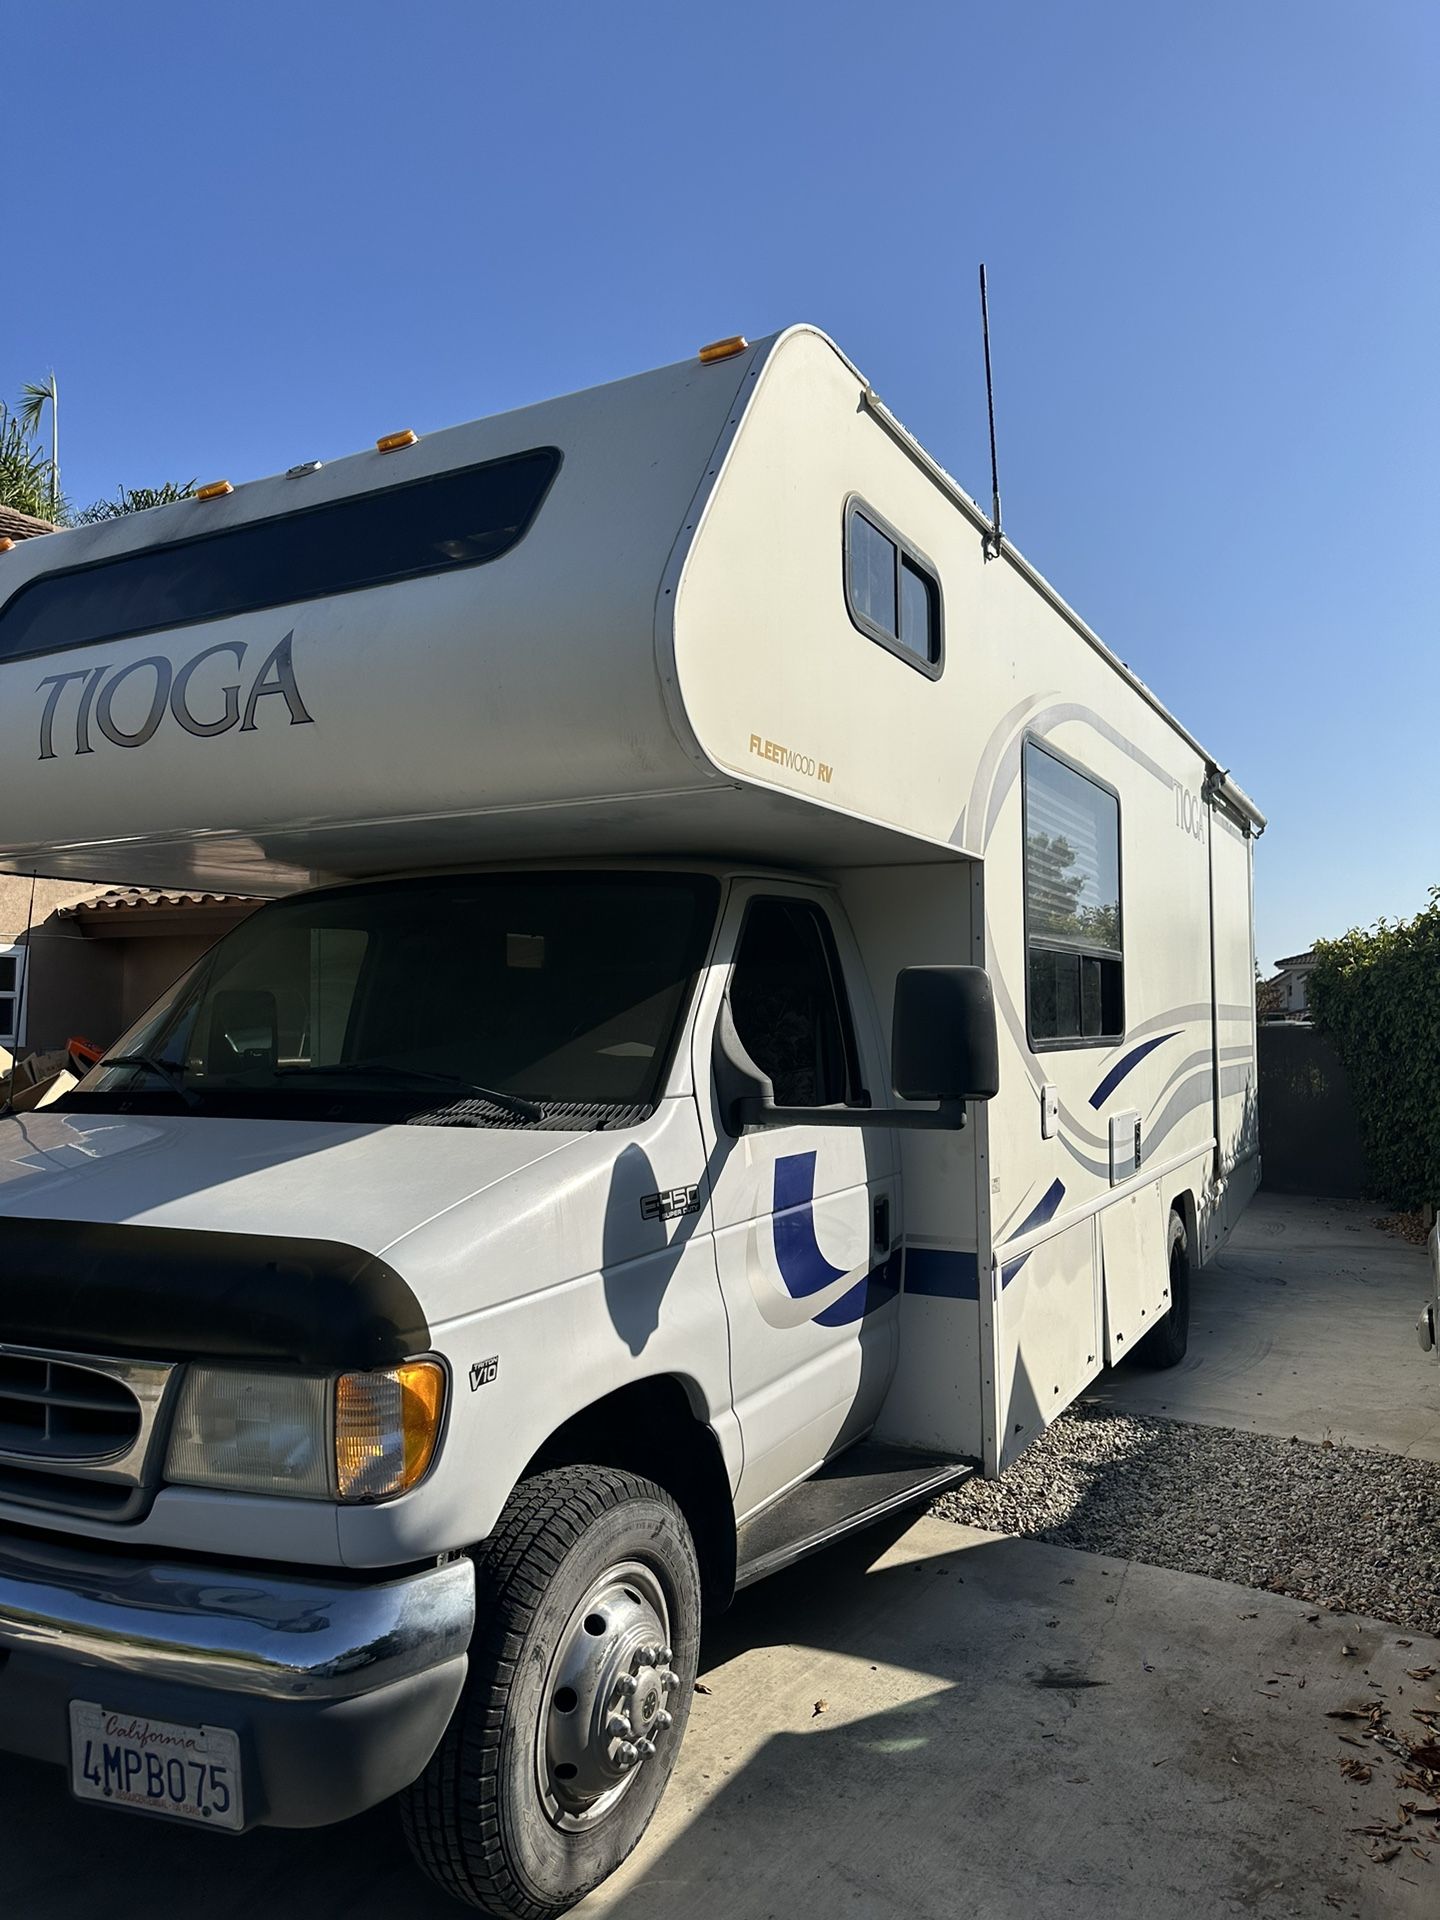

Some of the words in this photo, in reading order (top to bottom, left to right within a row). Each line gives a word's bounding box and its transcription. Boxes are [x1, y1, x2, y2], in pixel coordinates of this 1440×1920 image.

[35, 628, 315, 760] TIOGA
[749, 734, 815, 777] FLEETWOOD
[818, 763, 833, 783] RV
[1173, 779, 1205, 845] TIOGA
[470, 1364, 497, 1390] V10
[473, 1358, 498, 1370] TRITON
[105, 1715, 207, 1753] California
[83, 1740, 230, 1814] 4MPB075
